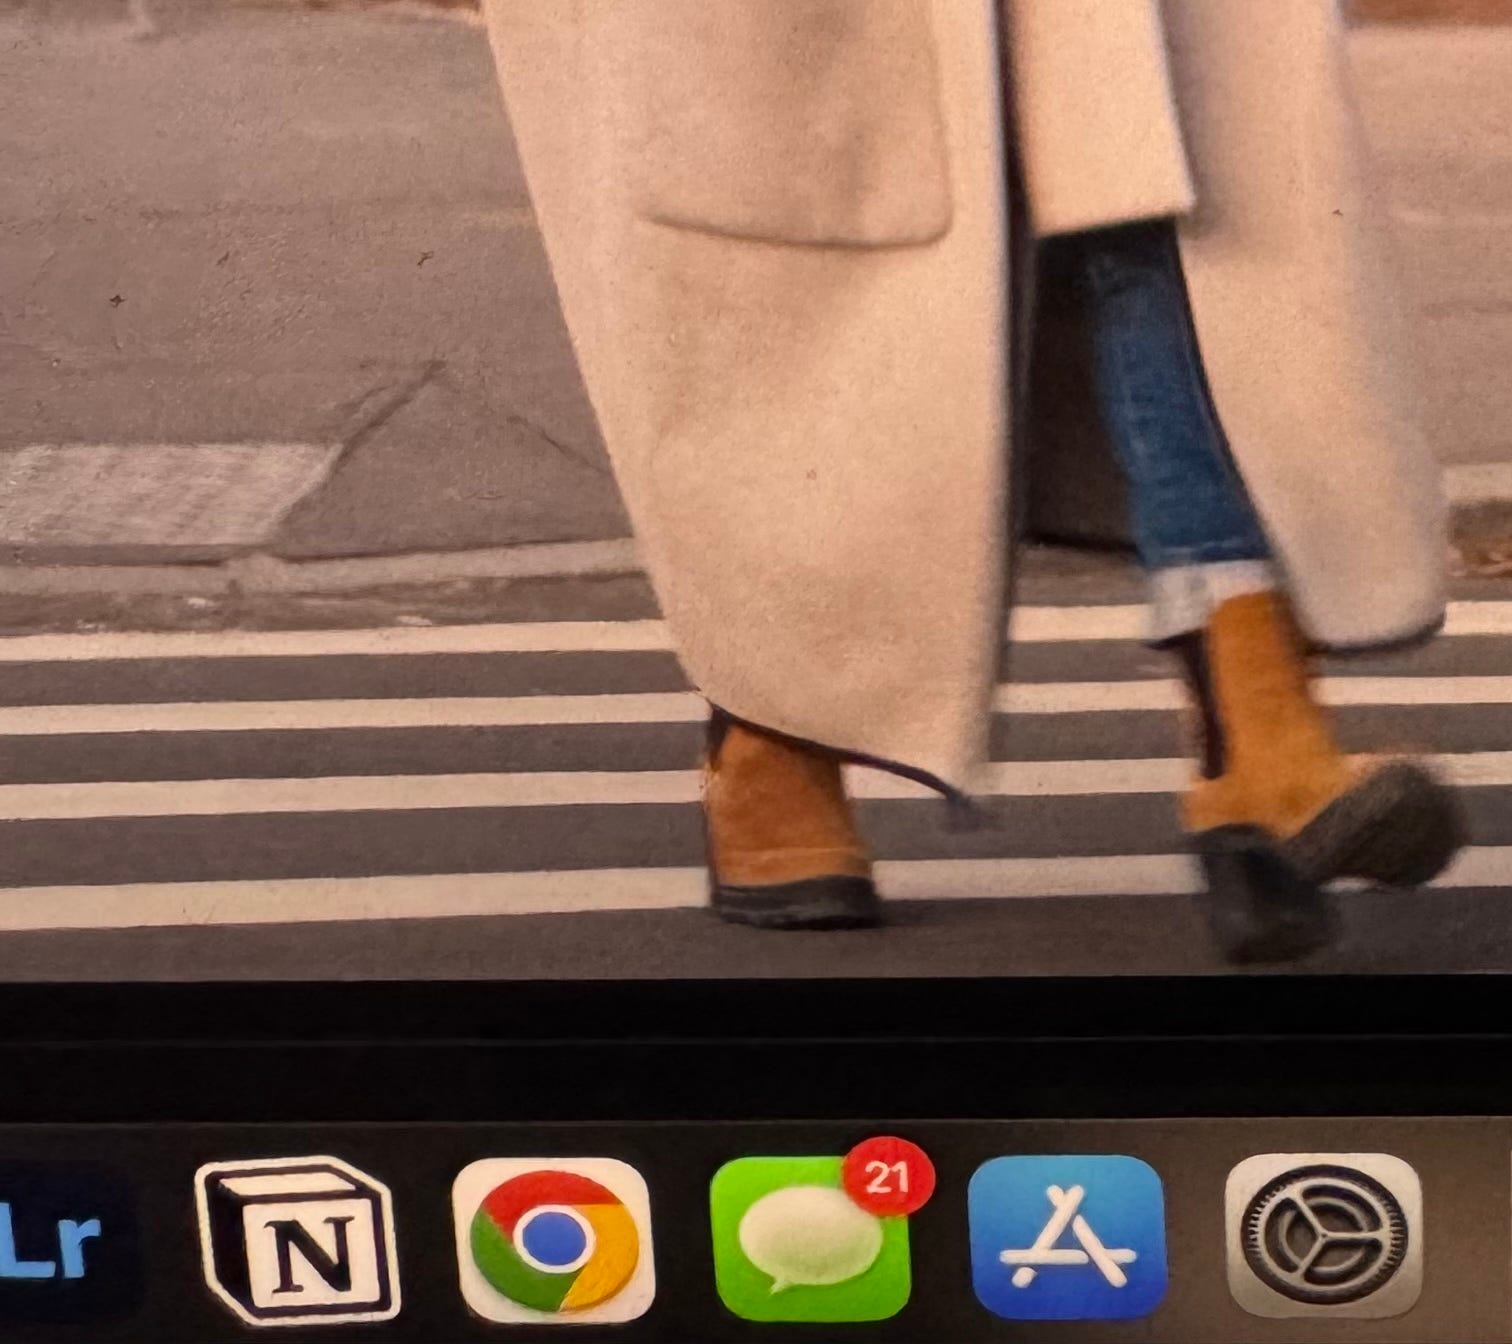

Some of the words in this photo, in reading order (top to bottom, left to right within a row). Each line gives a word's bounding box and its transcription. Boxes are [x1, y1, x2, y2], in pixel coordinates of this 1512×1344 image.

[865, 1160, 909, 1194] 21
[0, 1201, 101, 1279] Lr
[263, 1215, 356, 1294] N
